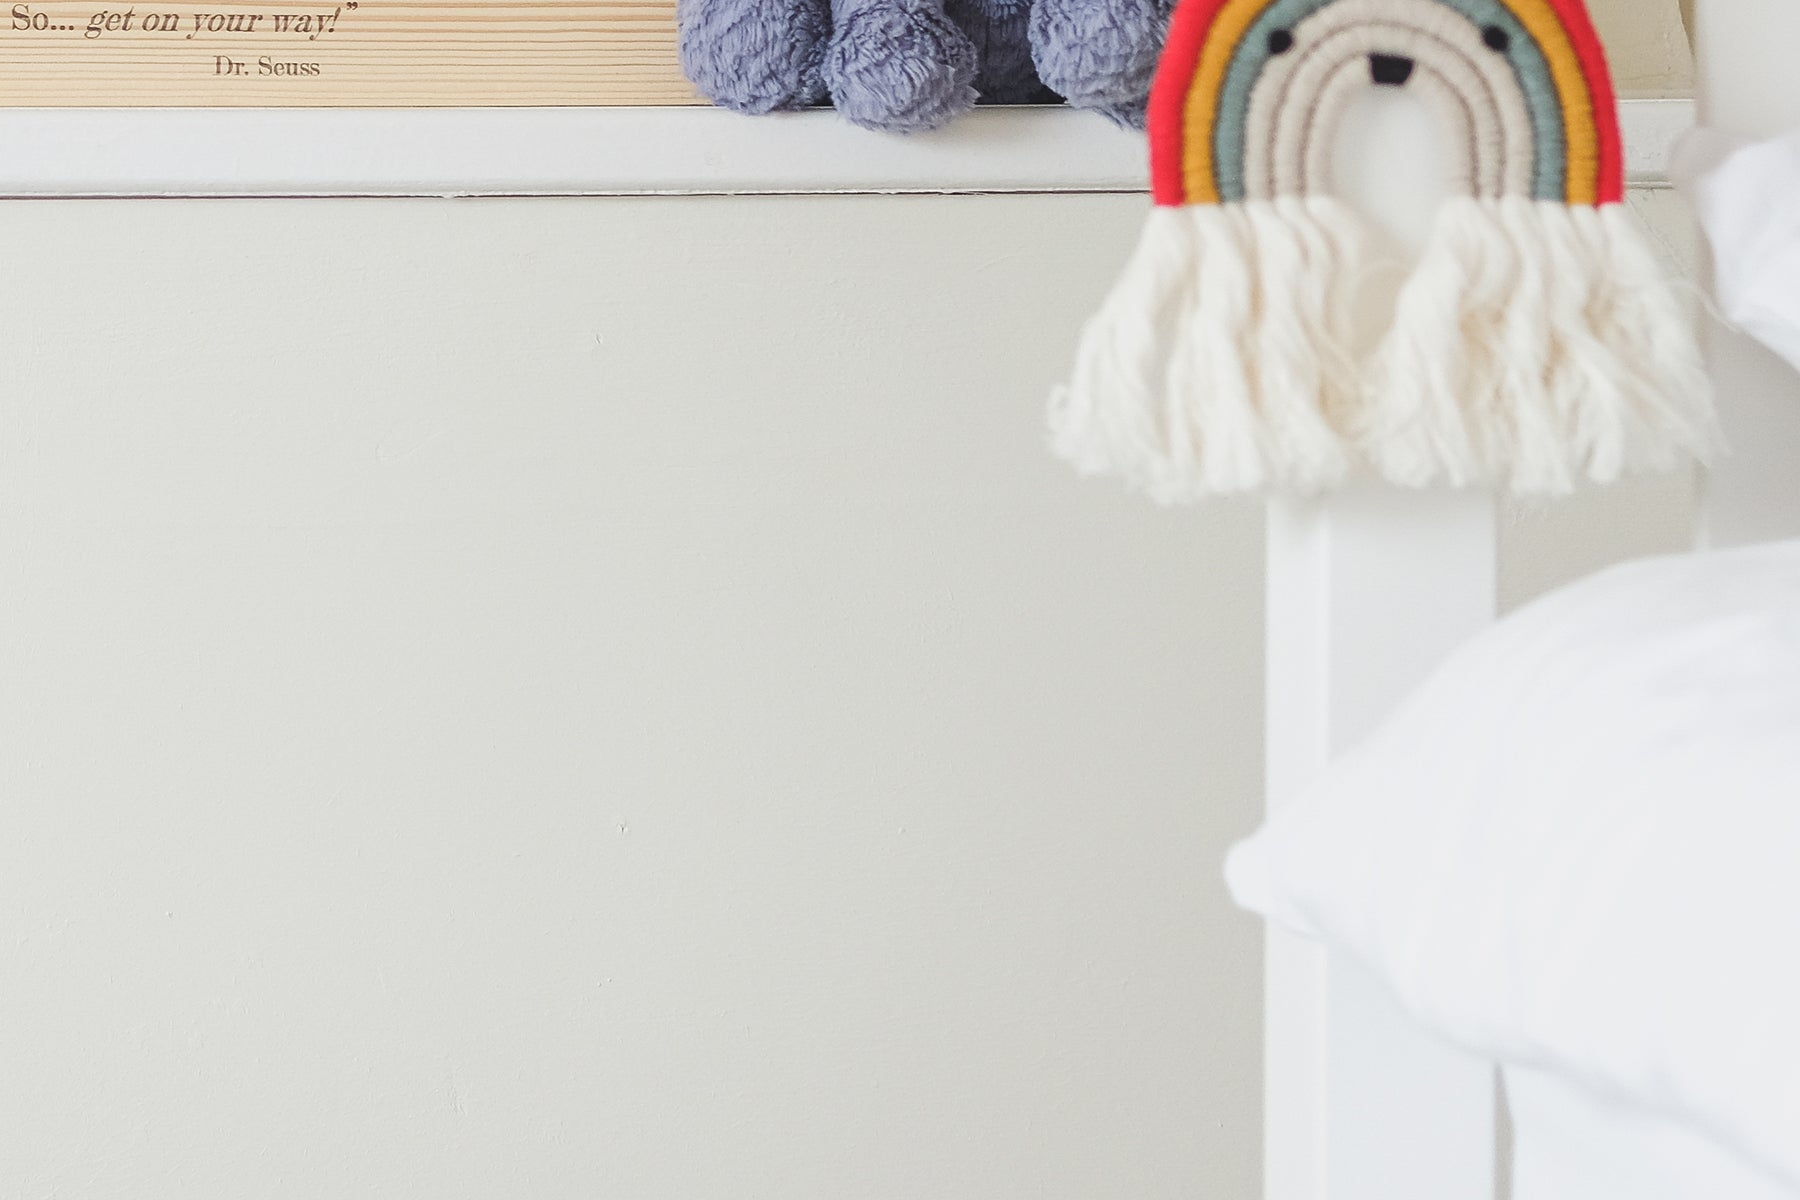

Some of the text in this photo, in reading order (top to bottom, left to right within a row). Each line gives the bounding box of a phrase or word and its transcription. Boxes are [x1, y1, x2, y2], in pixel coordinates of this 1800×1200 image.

[11, 2, 76, 32] So...
[84, 7, 140, 40] get
[140, 13, 180, 32] on
[185, 12, 264, 41] your
[213, 55, 322, 77] Dr. Seuss
